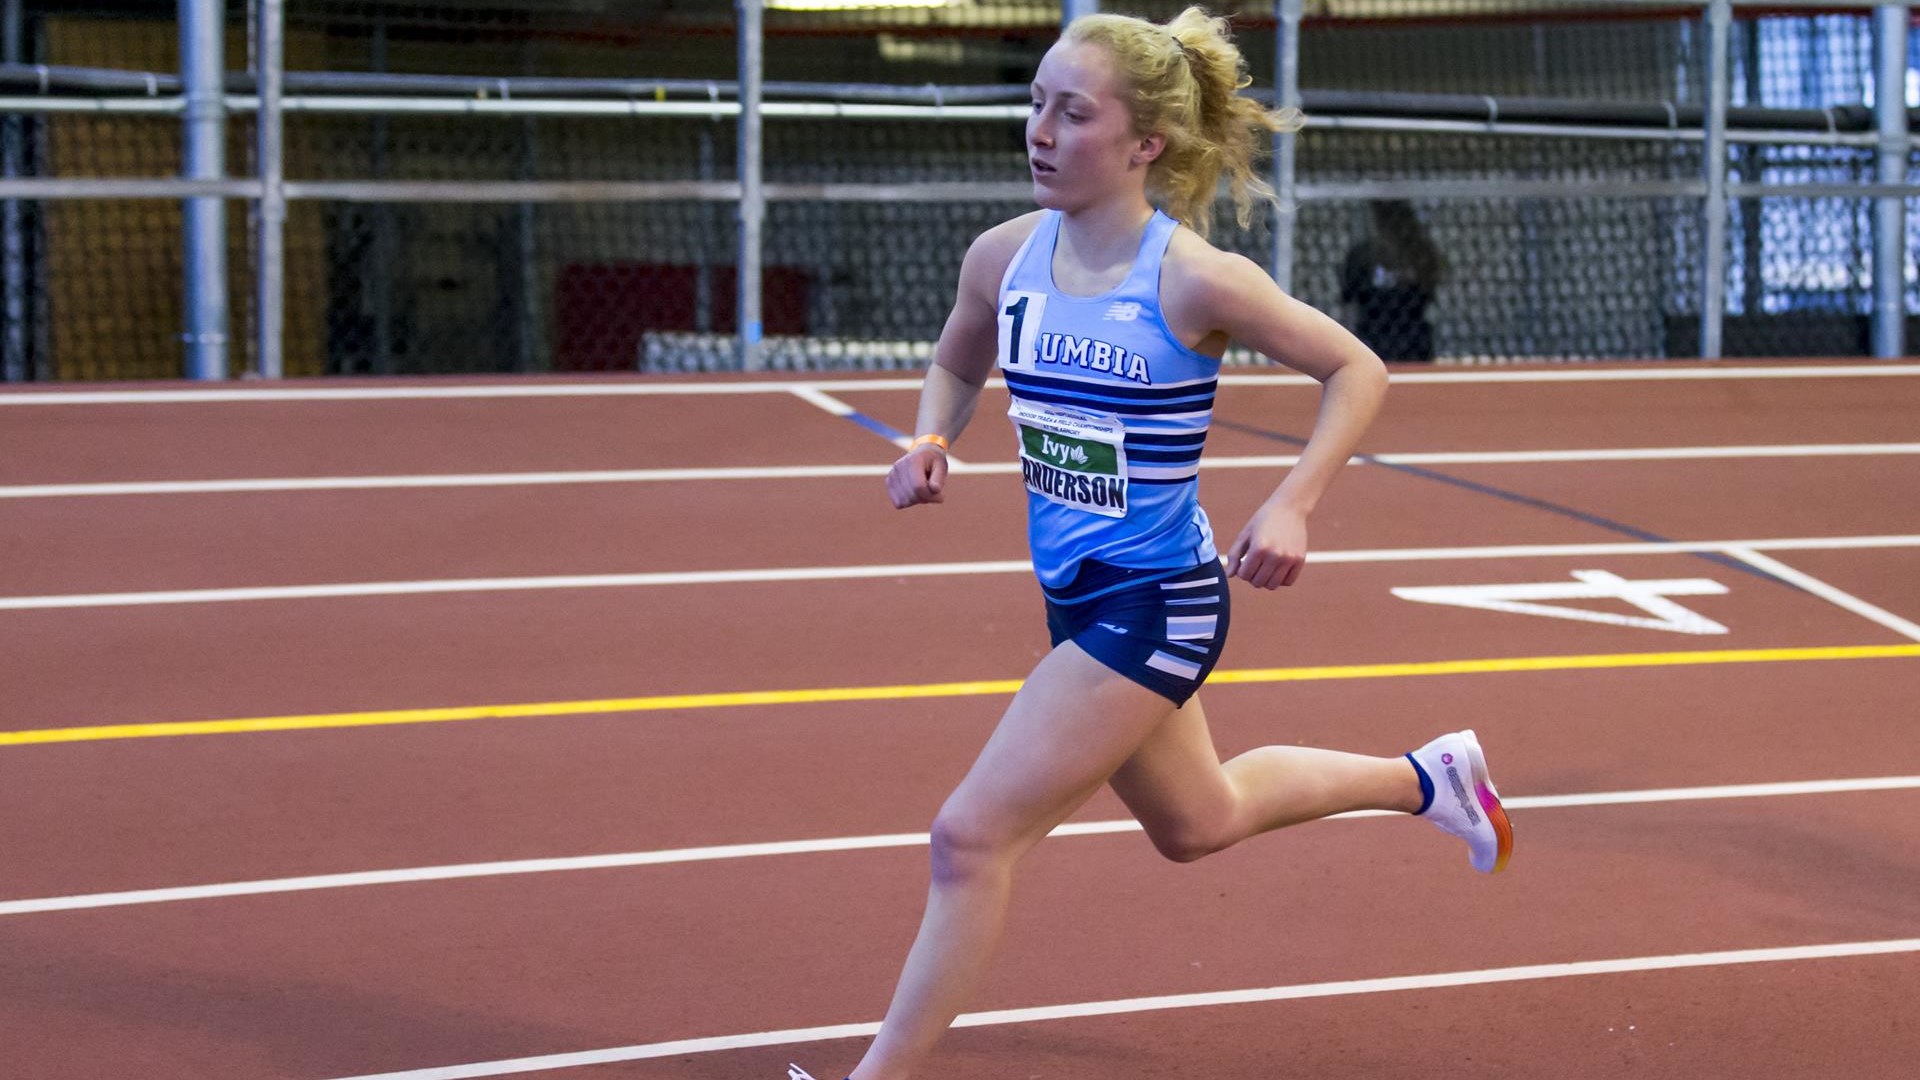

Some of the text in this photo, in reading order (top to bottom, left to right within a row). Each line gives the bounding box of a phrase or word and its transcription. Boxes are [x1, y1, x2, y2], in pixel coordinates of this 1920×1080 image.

[1005, 296, 1029, 364] 1
[1042, 434, 1070, 464] Ivy
[1021, 456, 1125, 509] ANDERSON
[1390, 569, 1730, 635] 4
